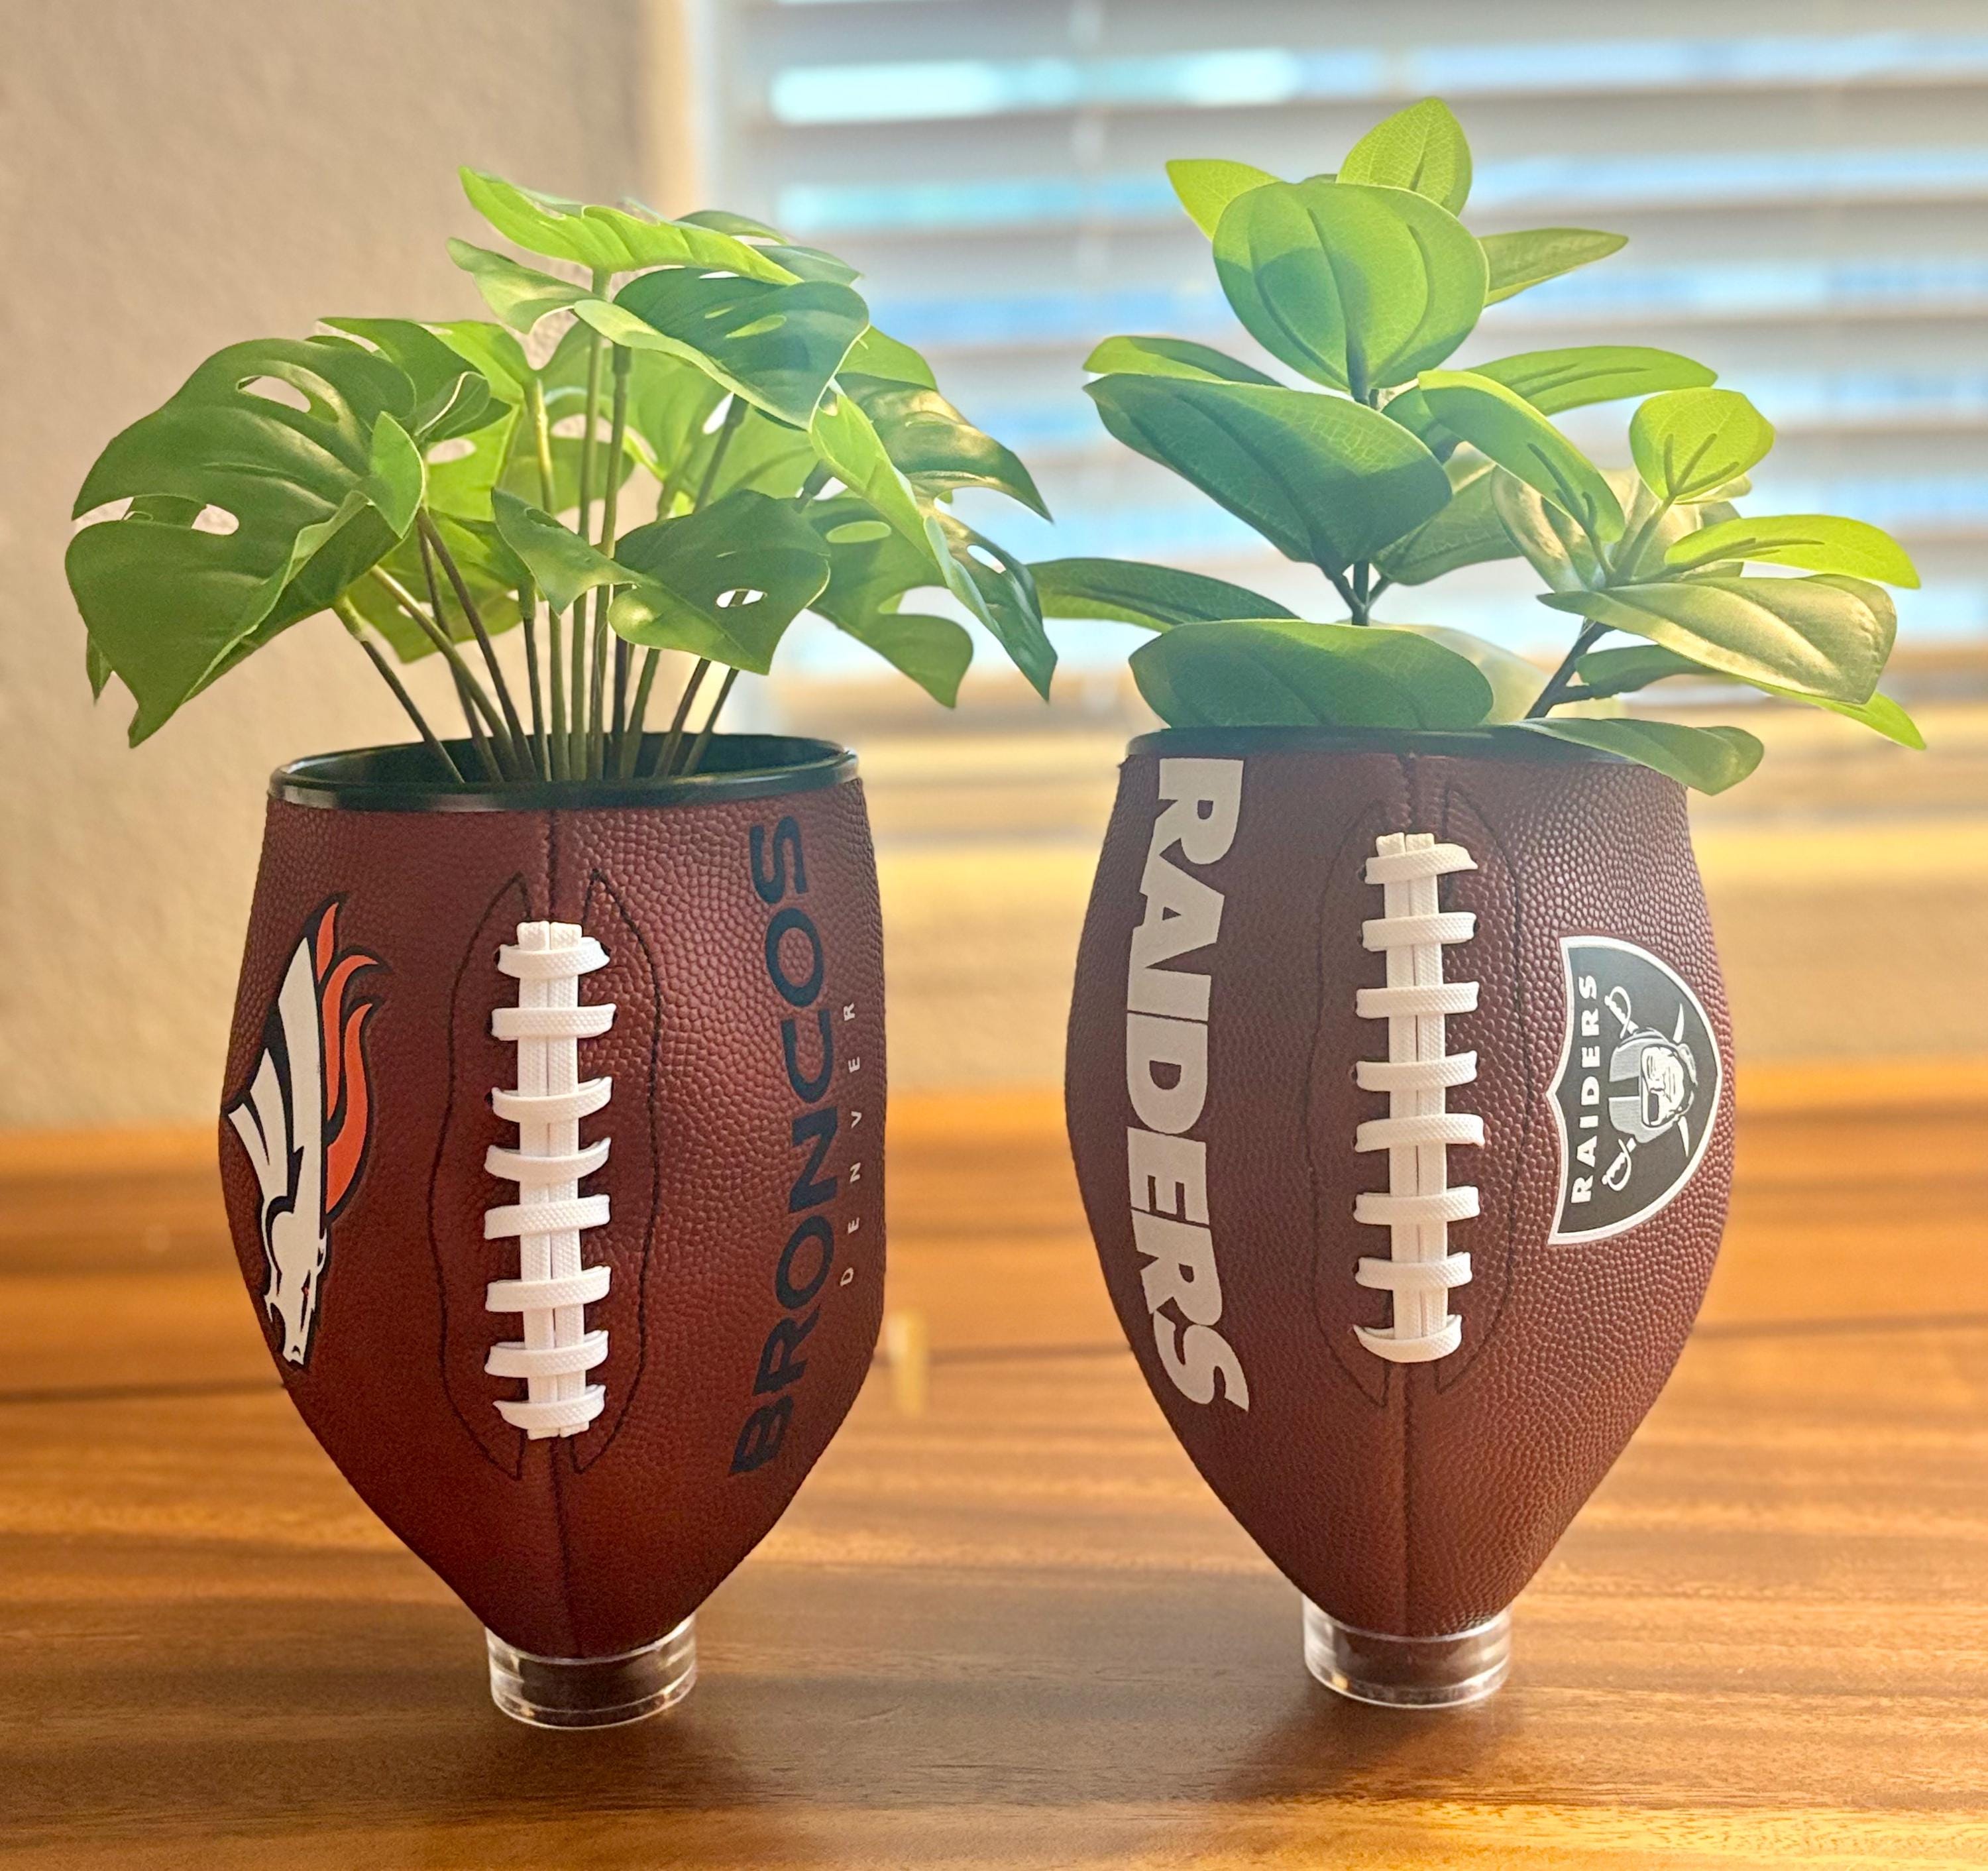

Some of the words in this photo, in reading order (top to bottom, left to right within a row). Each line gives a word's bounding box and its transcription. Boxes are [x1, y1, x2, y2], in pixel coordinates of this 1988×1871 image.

[730, 816, 838, 1473] BRONCOS
[839, 1003, 863, 1286] DENVER
[1126, 758, 1248, 1412] RAIDERS
[1571, 975, 1600, 1203] RAIDERS
